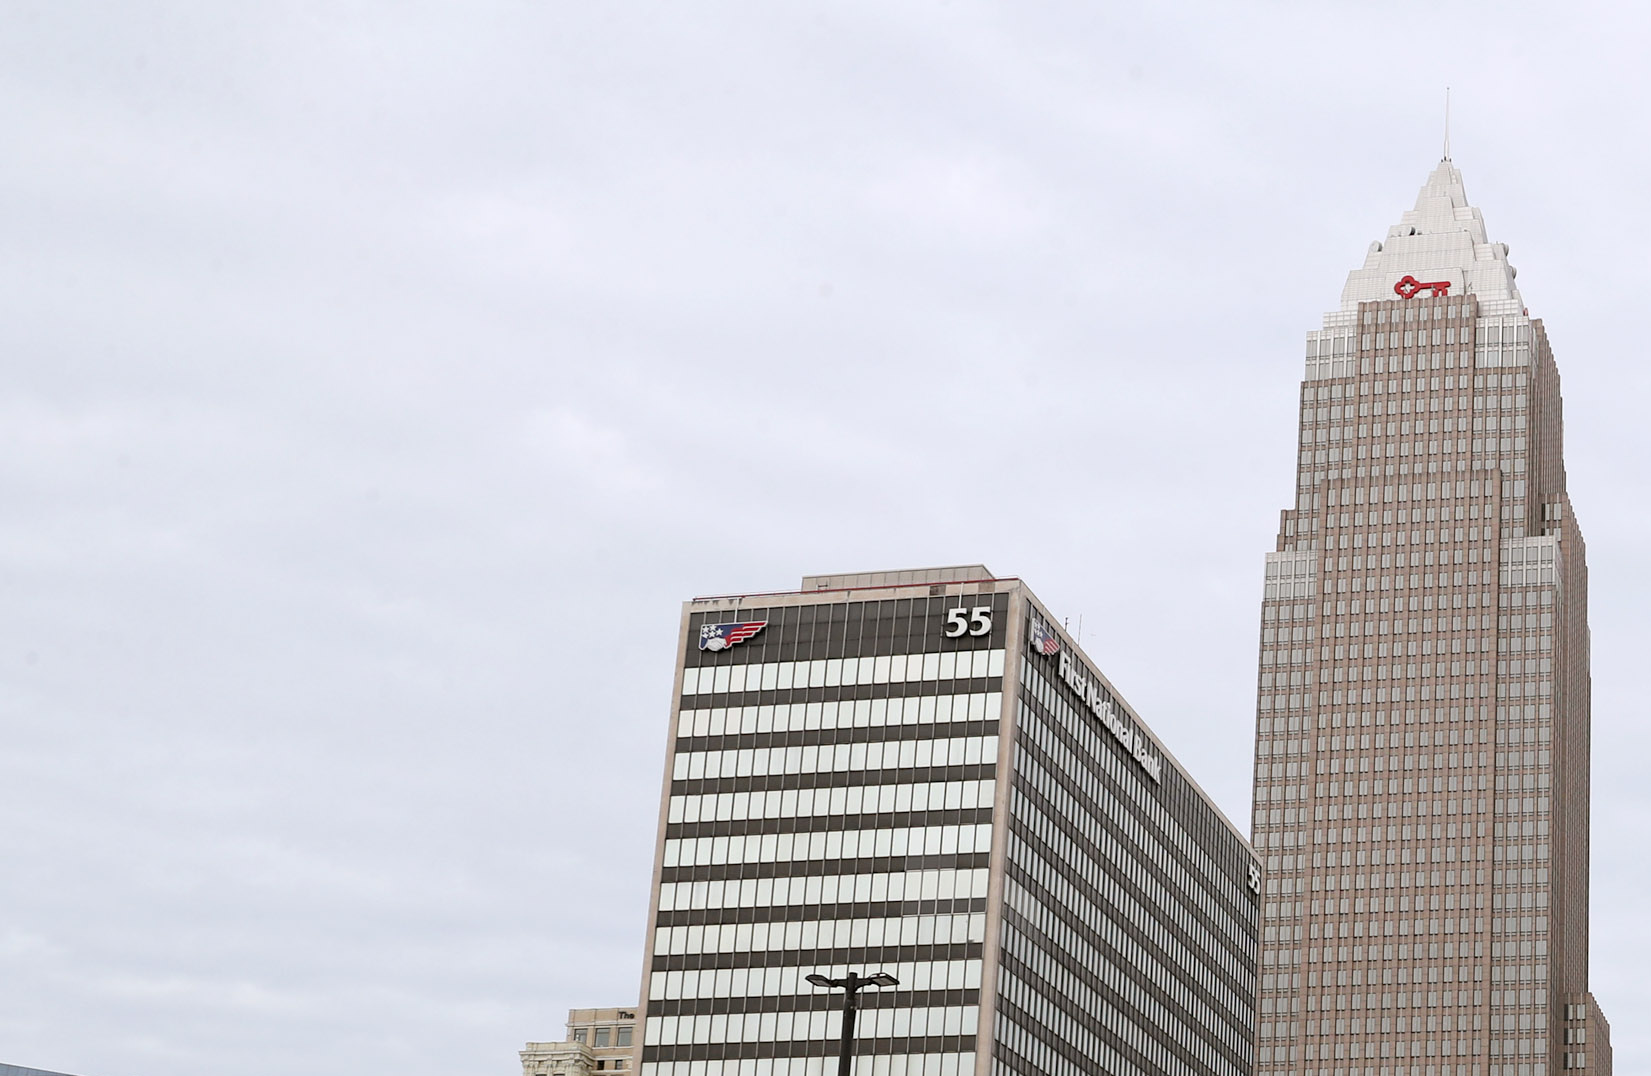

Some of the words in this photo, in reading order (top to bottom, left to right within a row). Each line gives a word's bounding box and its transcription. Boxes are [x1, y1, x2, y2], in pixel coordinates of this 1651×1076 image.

[945, 606, 992, 638] 55
[1058, 651, 1088, 701] First
[1086, 683, 1133, 753] National
[1133, 734, 1162, 785] Bank
[1248, 864, 1261, 895] 55
